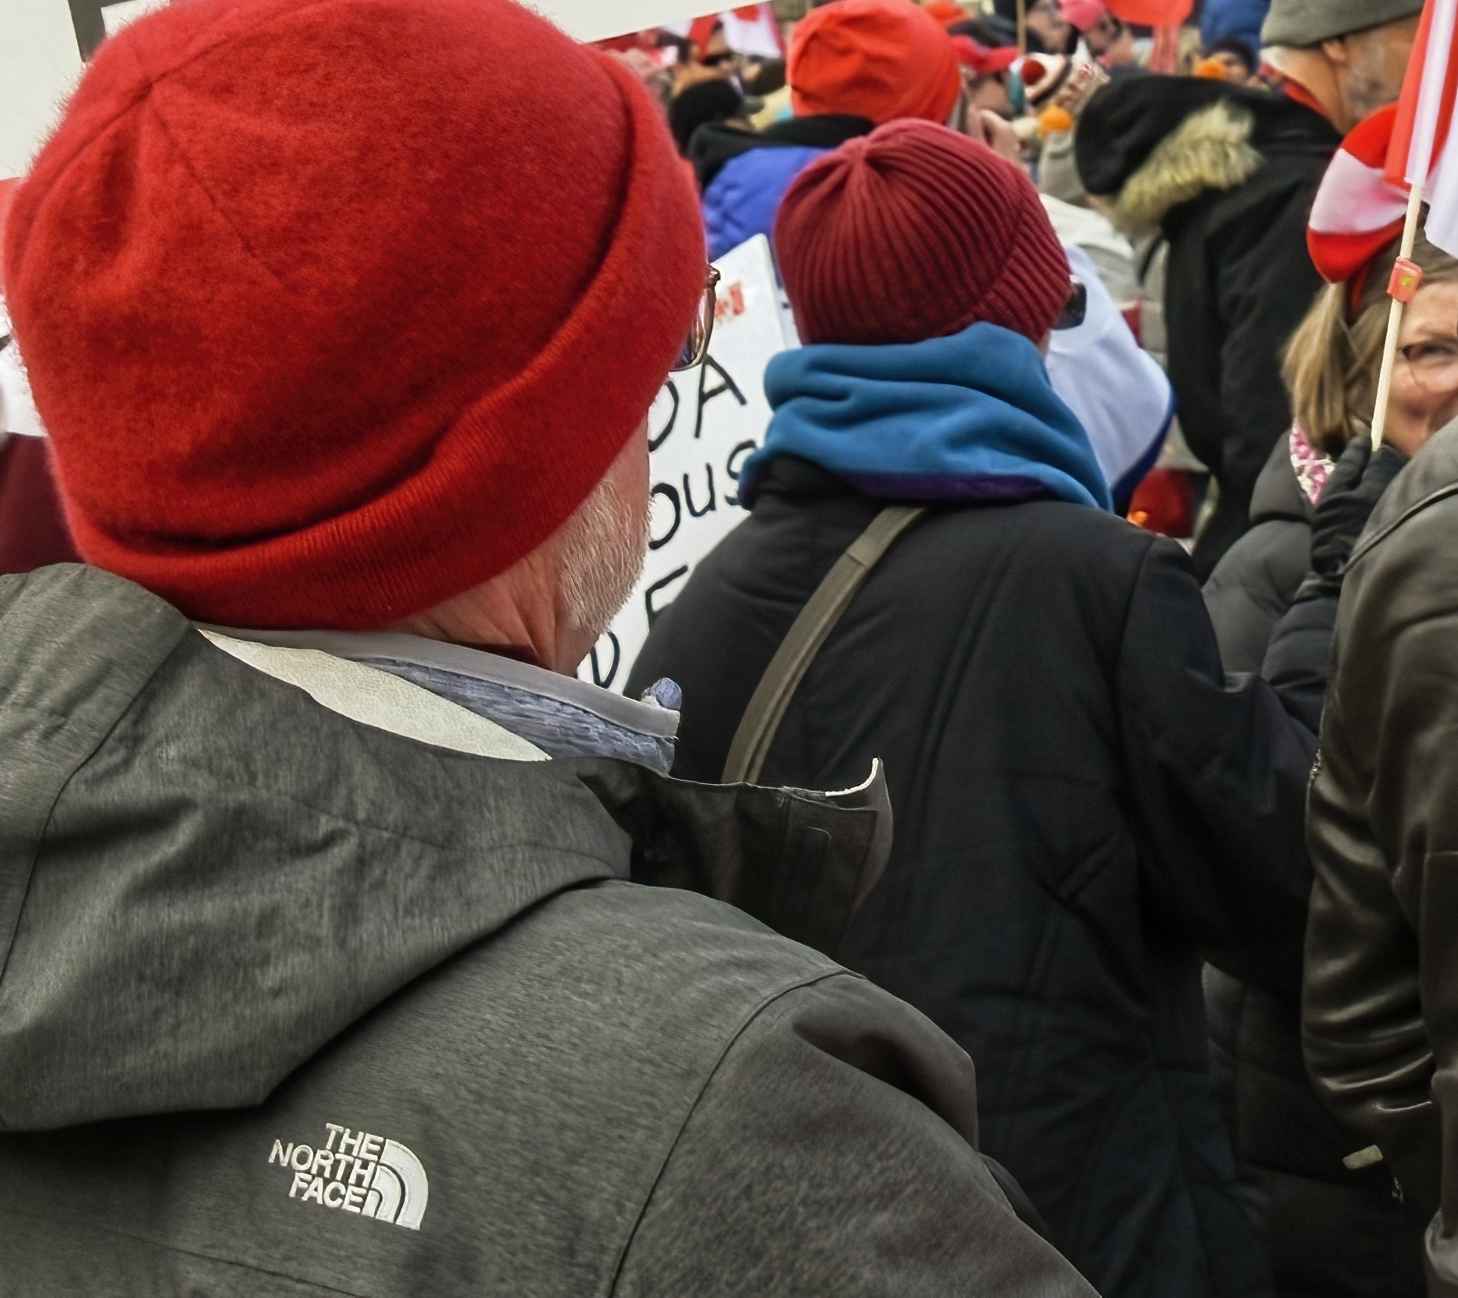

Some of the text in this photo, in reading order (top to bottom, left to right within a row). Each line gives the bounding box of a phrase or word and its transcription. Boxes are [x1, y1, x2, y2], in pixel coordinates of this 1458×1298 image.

[267, 1138, 377, 1188] NORTH
[325, 1122, 385, 1161] THE
[288, 1171, 368, 1214] FACE
